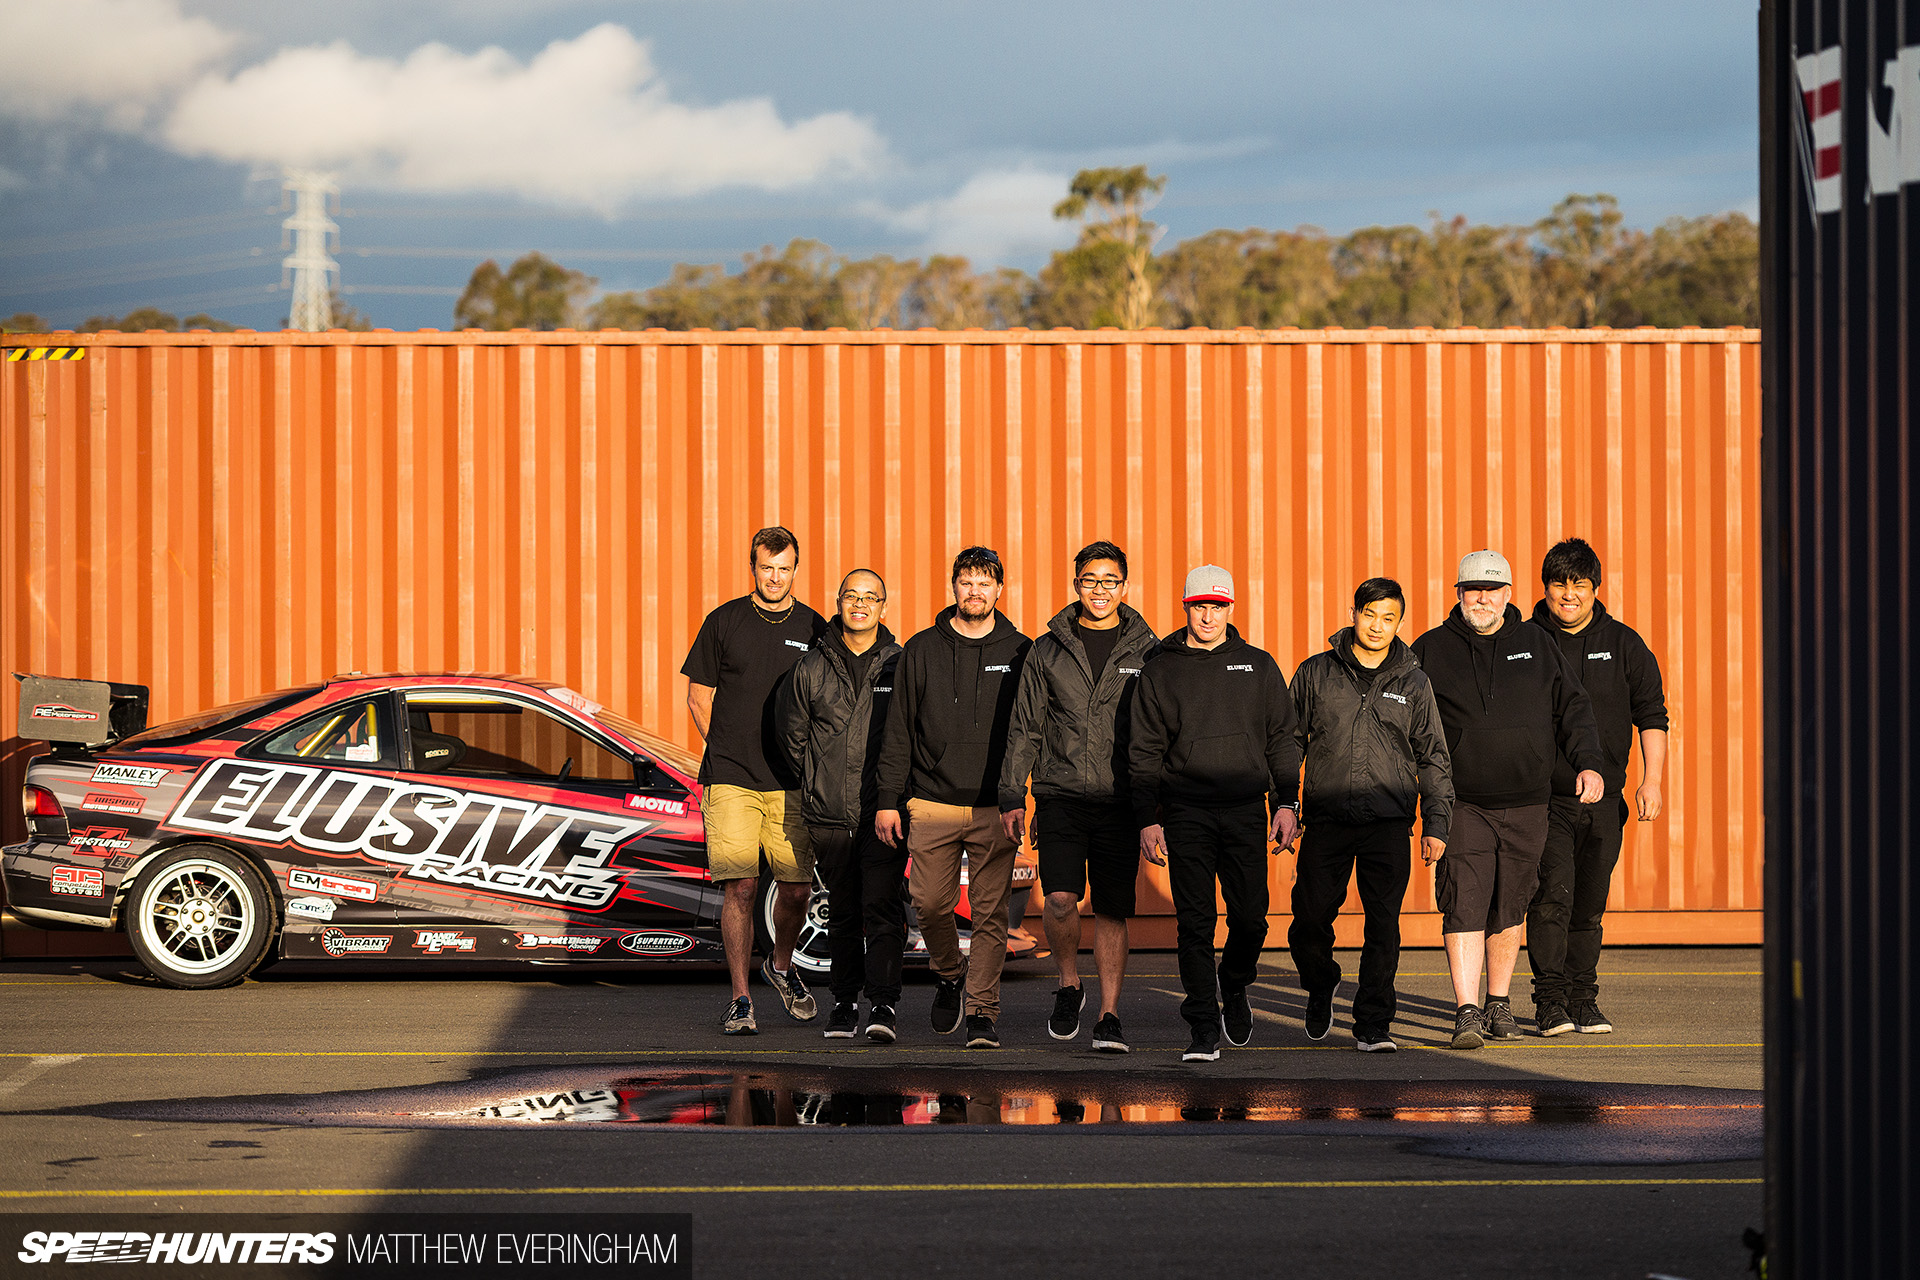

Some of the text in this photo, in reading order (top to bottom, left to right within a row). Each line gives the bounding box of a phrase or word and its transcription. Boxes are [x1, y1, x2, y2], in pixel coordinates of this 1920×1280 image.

[97, 766, 158, 779] MANLEY
[630, 795, 684, 815] MOTUL
[174, 759, 644, 880] ELUSIVE
[408, 858, 612, 904] RACING
[332, 939, 388, 947] VIBRANT
[636, 937, 685, 946] SUPERTECH
